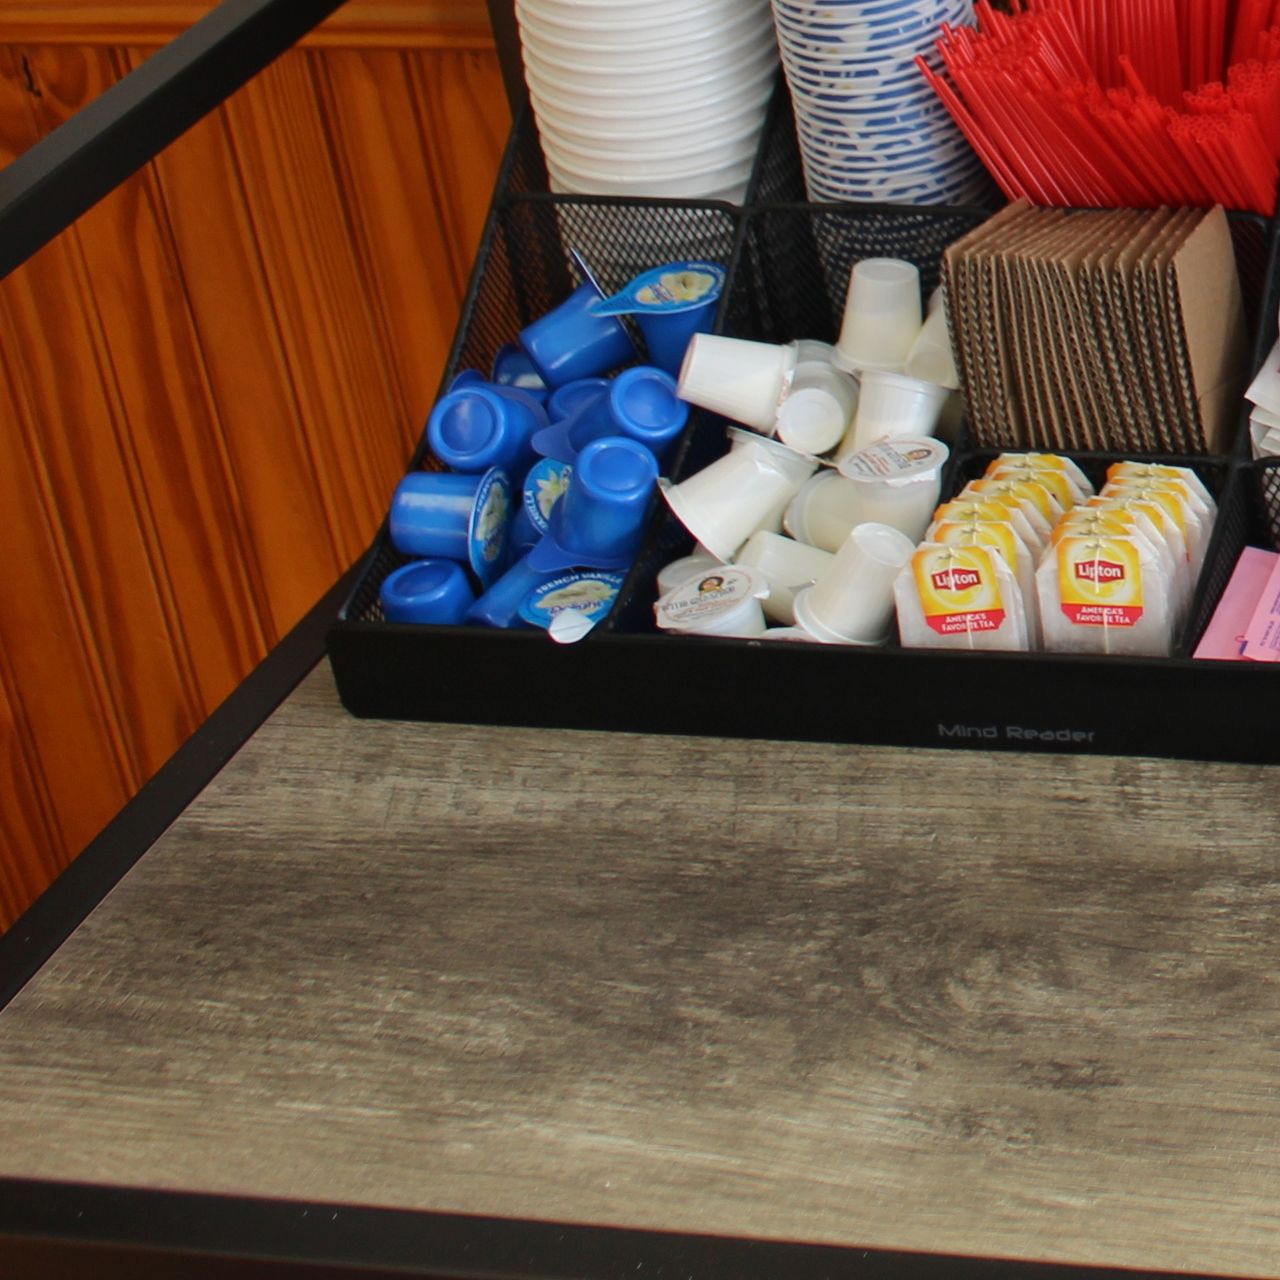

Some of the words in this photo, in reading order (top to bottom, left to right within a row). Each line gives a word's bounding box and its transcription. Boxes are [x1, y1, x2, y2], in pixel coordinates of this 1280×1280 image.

[1078, 564, 1122, 579] Lipton
[536, 574, 580, 595] FRENCH
[935, 572, 978, 589] Lipton
[1081, 606, 1124, 615] AMERCA'S
[945, 613, 987, 623] AMERCA'S
[1076, 613, 1114, 622] FAVORTE
[1115, 615, 1130, 624] TEA
[942, 622, 978, 632] FAVORTE
[979, 620, 995, 629] TEA
[938, 723, 998, 738] Mind
[1006, 726, 1096, 743] Reader
